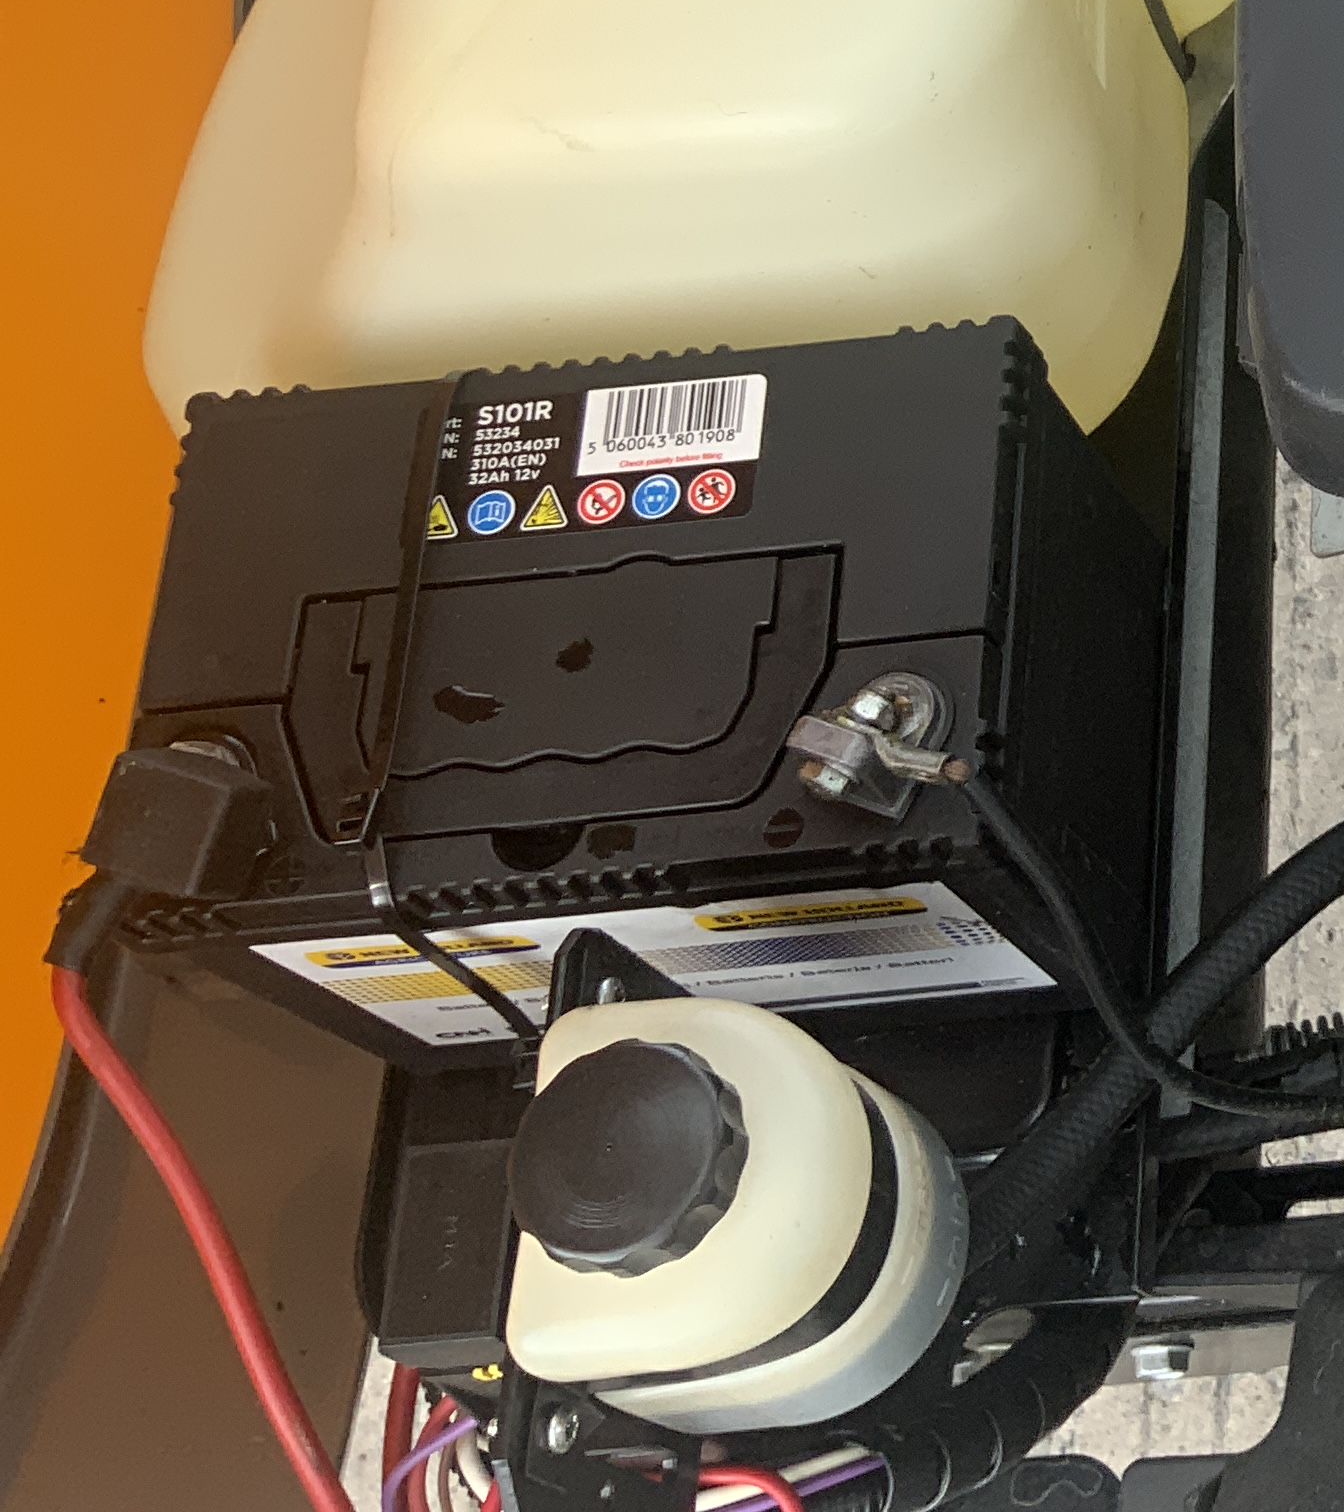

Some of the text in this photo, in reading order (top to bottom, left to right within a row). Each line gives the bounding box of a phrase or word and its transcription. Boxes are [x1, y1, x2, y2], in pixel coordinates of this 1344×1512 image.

[477, 400, 554, 426] S101R
[474, 426, 521, 442] 53234
[472, 437, 560, 457] 532034031
[585, 441, 597, 455] 5
[606, 435, 667, 453] 060043
[470, 453, 547, 471] 310A(EN)
[619, 460, 645, 469] Check
[468, 470, 510, 486] 32Ah
